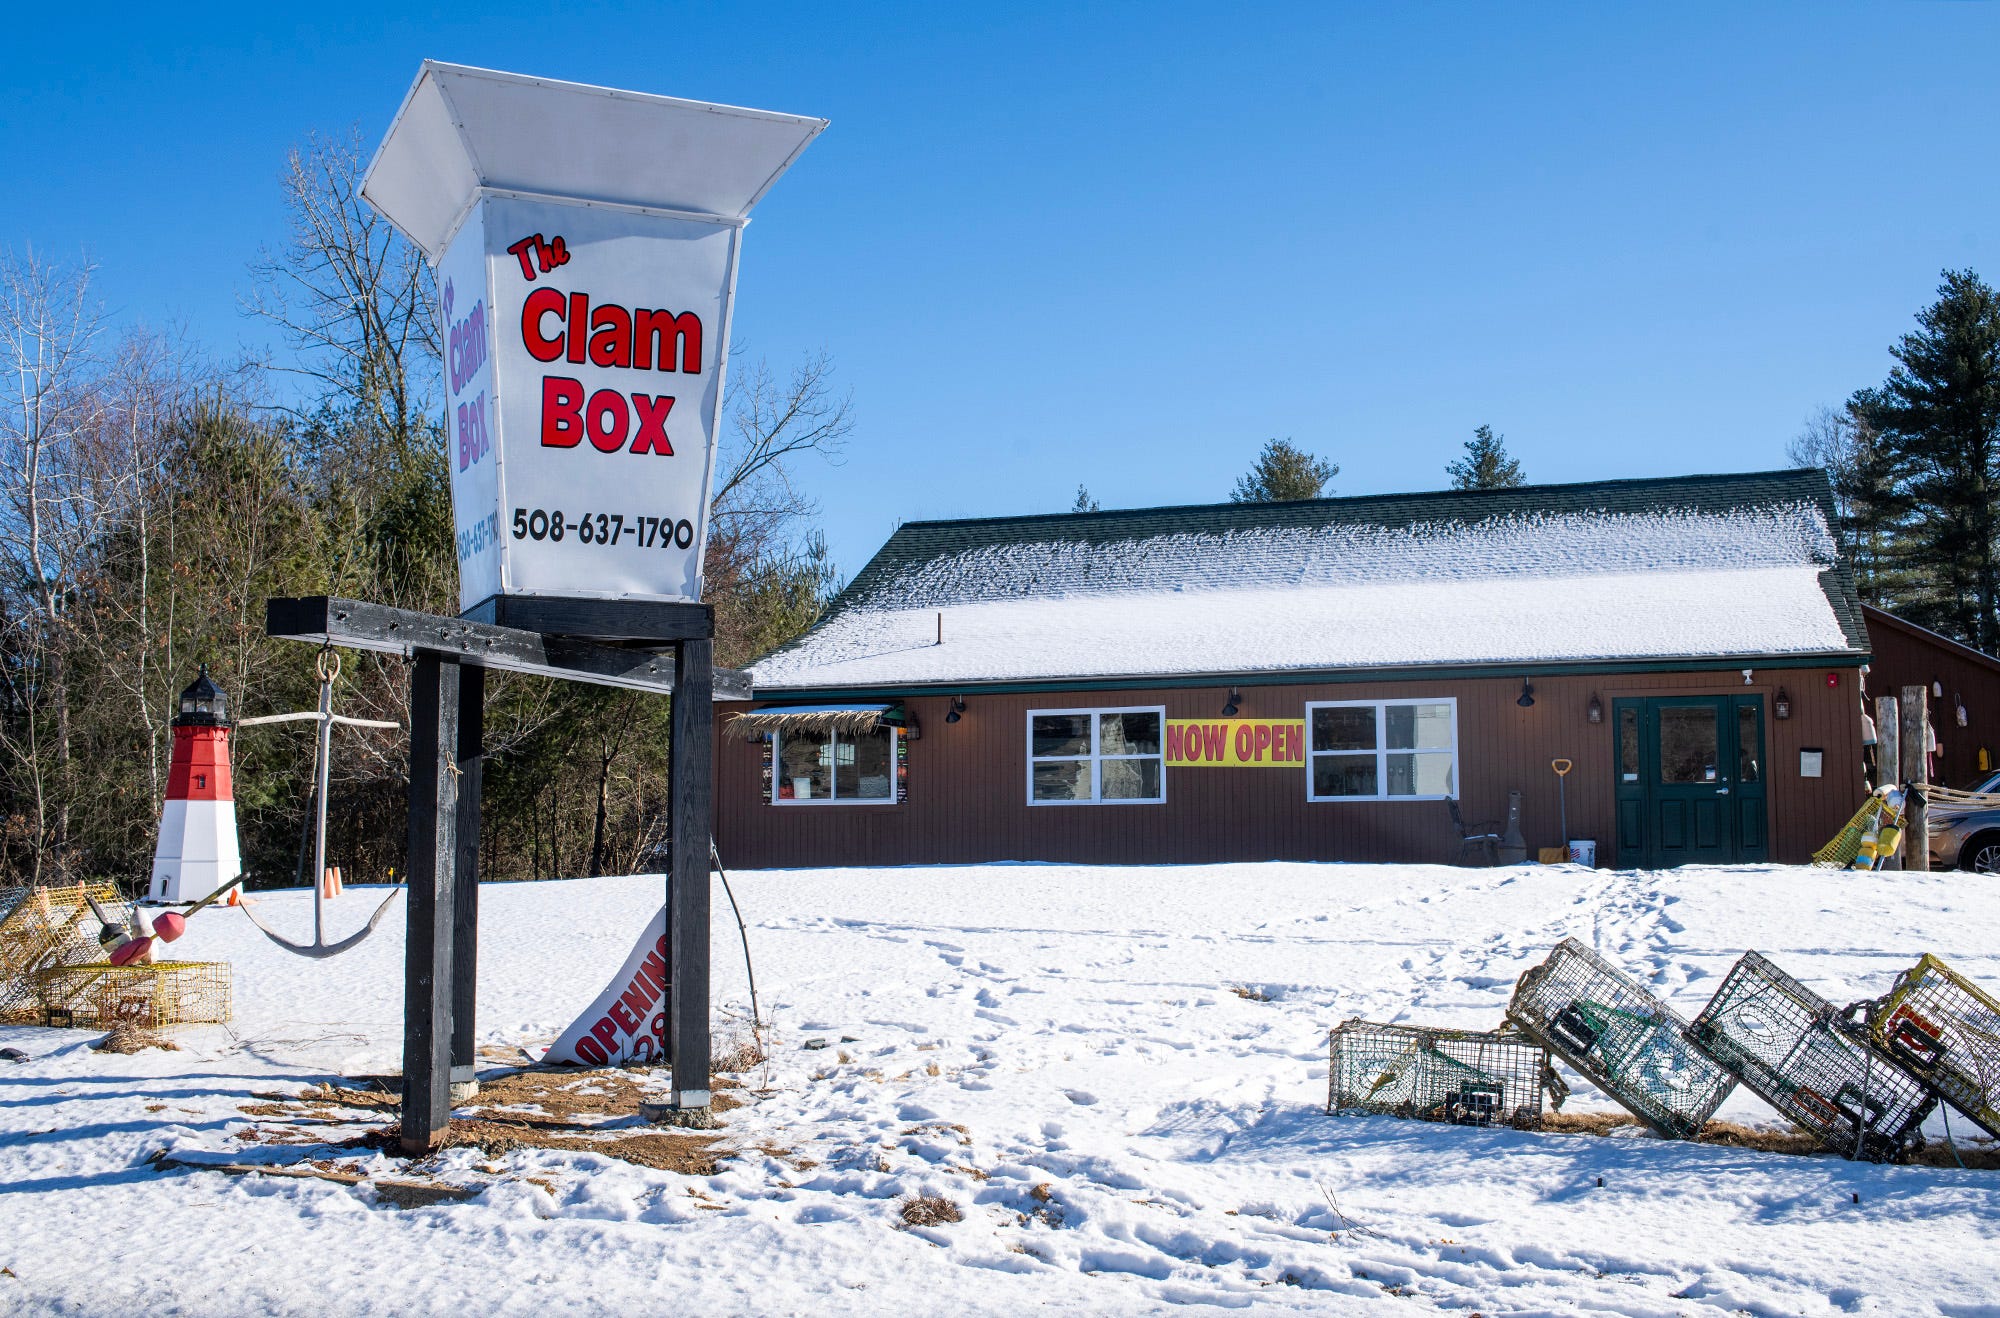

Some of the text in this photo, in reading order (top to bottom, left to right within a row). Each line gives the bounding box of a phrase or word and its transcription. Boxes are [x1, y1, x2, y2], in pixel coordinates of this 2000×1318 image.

[507, 233, 570, 281] The
[449, 298, 487, 397] Clam
[521, 286, 703, 374] Clam
[512, 508, 694, 550] 508-637-1790
[1166, 724, 1303, 762] NOW OPEN
